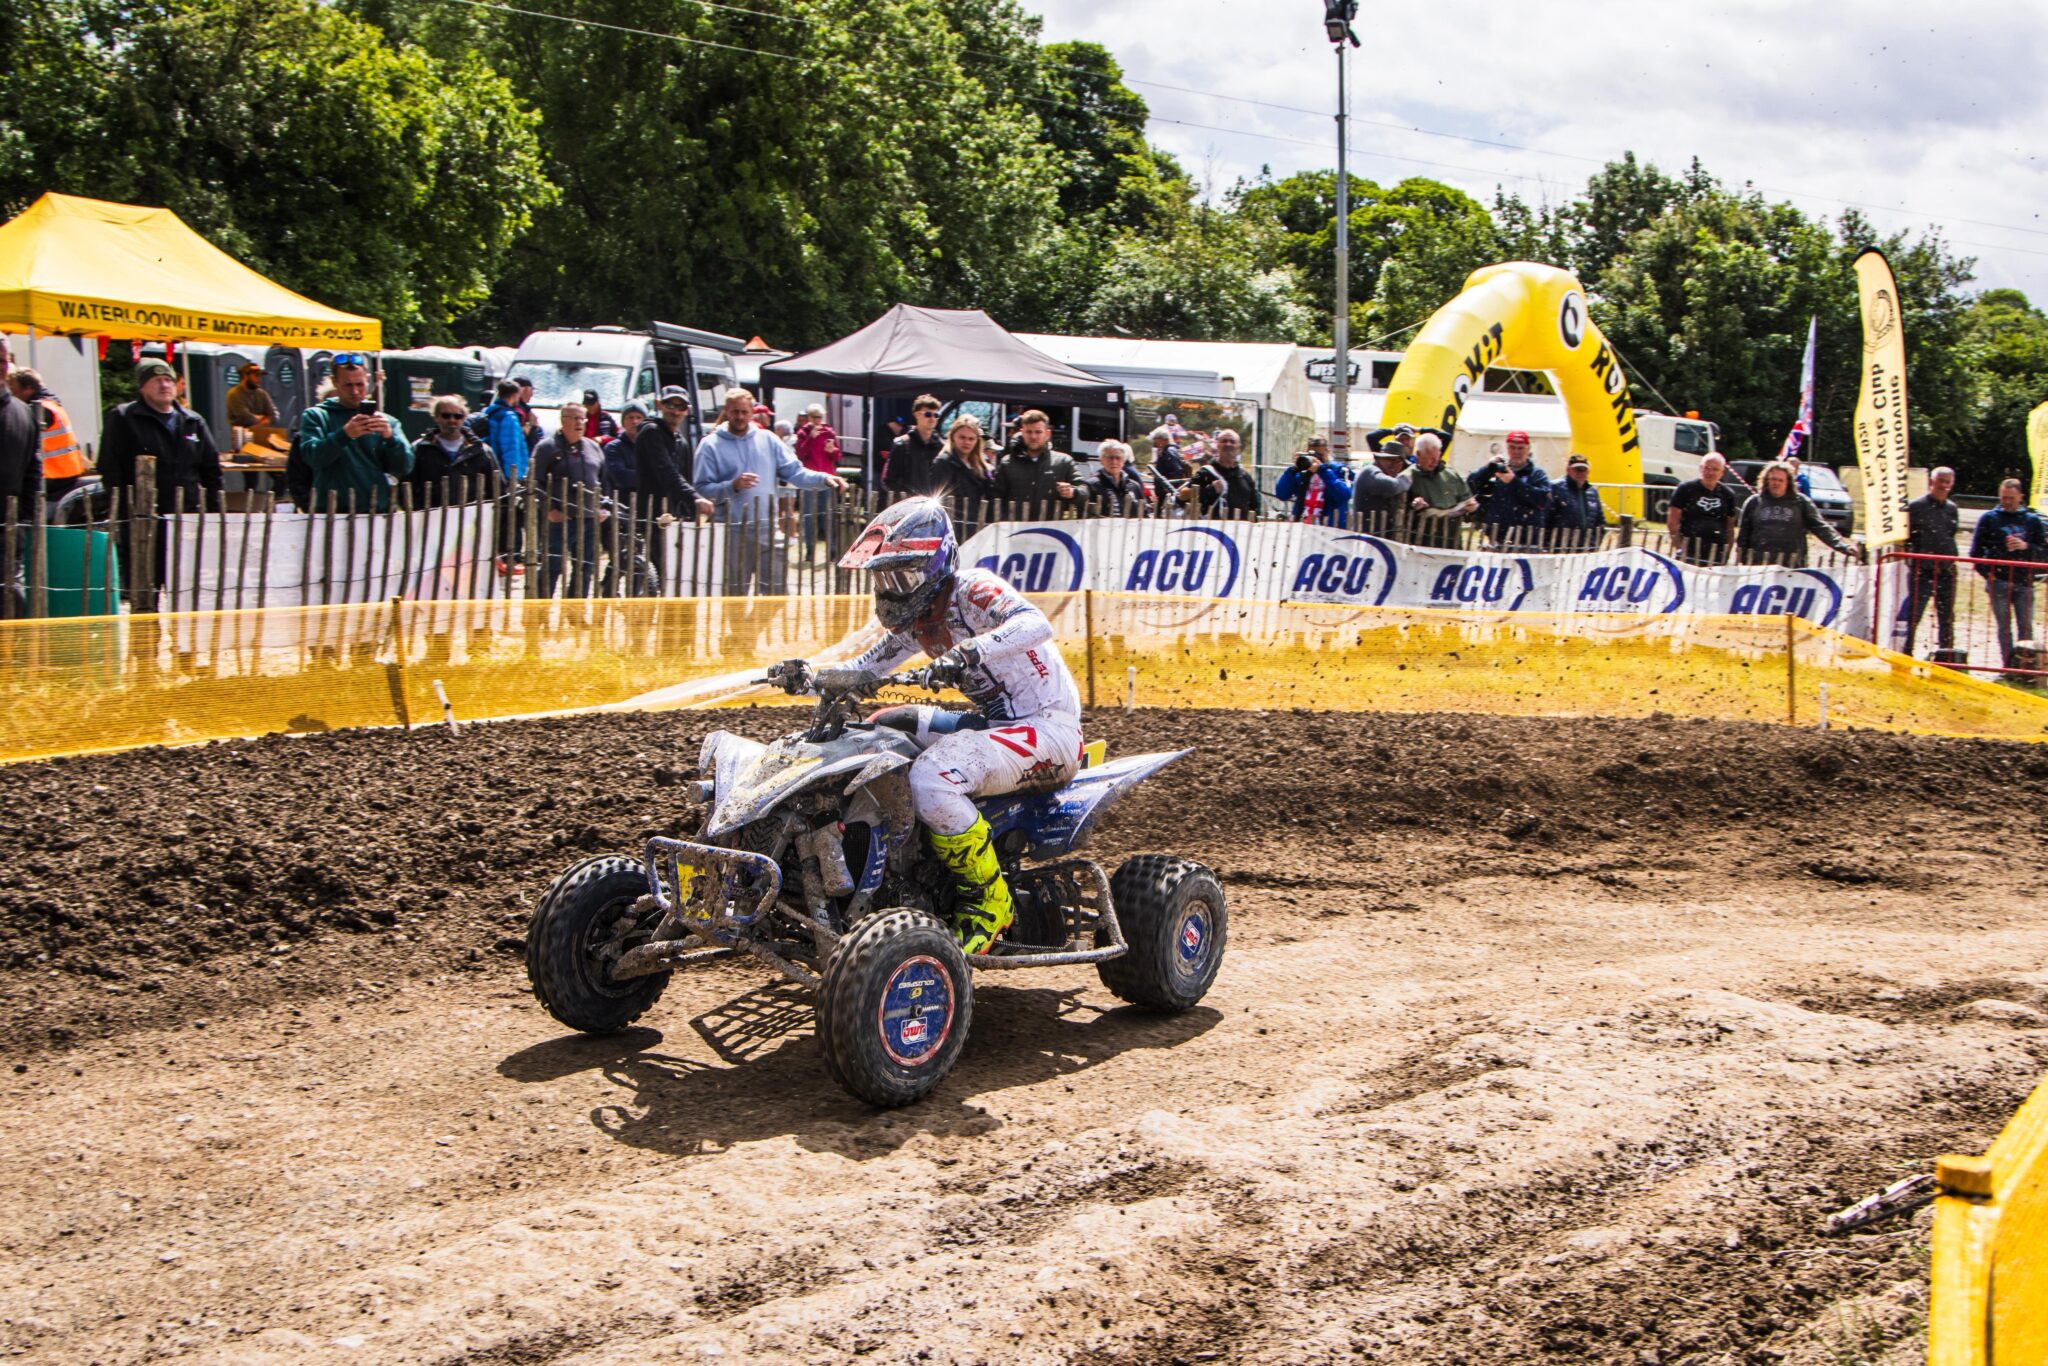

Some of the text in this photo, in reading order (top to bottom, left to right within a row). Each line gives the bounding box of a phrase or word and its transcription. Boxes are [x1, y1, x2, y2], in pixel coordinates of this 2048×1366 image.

[58, 300, 363, 341] WATERLOOVILLE MOTORCYCLE CLUB
[1125, 549, 1214, 592] ACU
[1291, 553, 1375, 596] ACU
[1430, 564, 1511, 602] ACU
[1577, 565, 1660, 603] ACU
[1728, 583, 1817, 618] ACU
